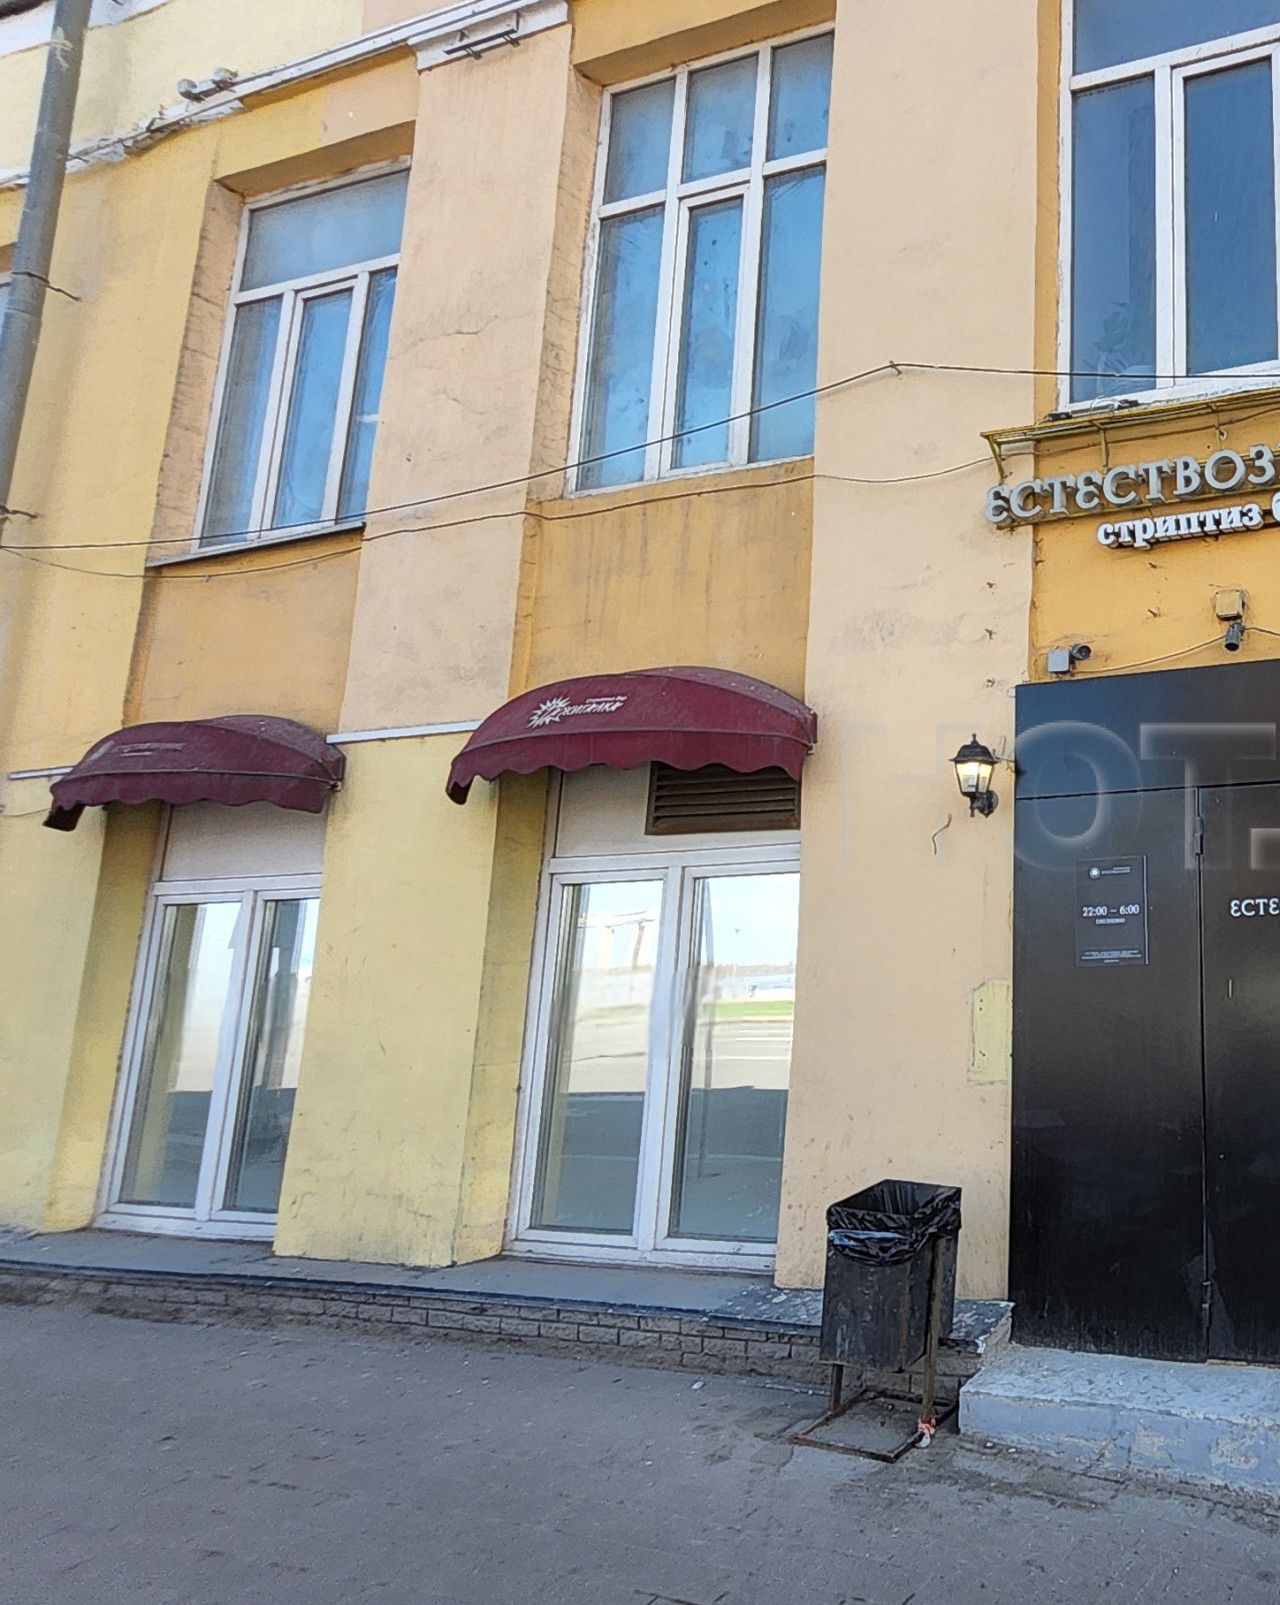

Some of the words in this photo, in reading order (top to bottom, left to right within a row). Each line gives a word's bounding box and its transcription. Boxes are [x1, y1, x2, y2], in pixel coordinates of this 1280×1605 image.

[1098, 500, 1262, 549] стриптиз
[1082, 905, 1107, 917] 22:00
[1119, 904, 1139, 915] 6:00
